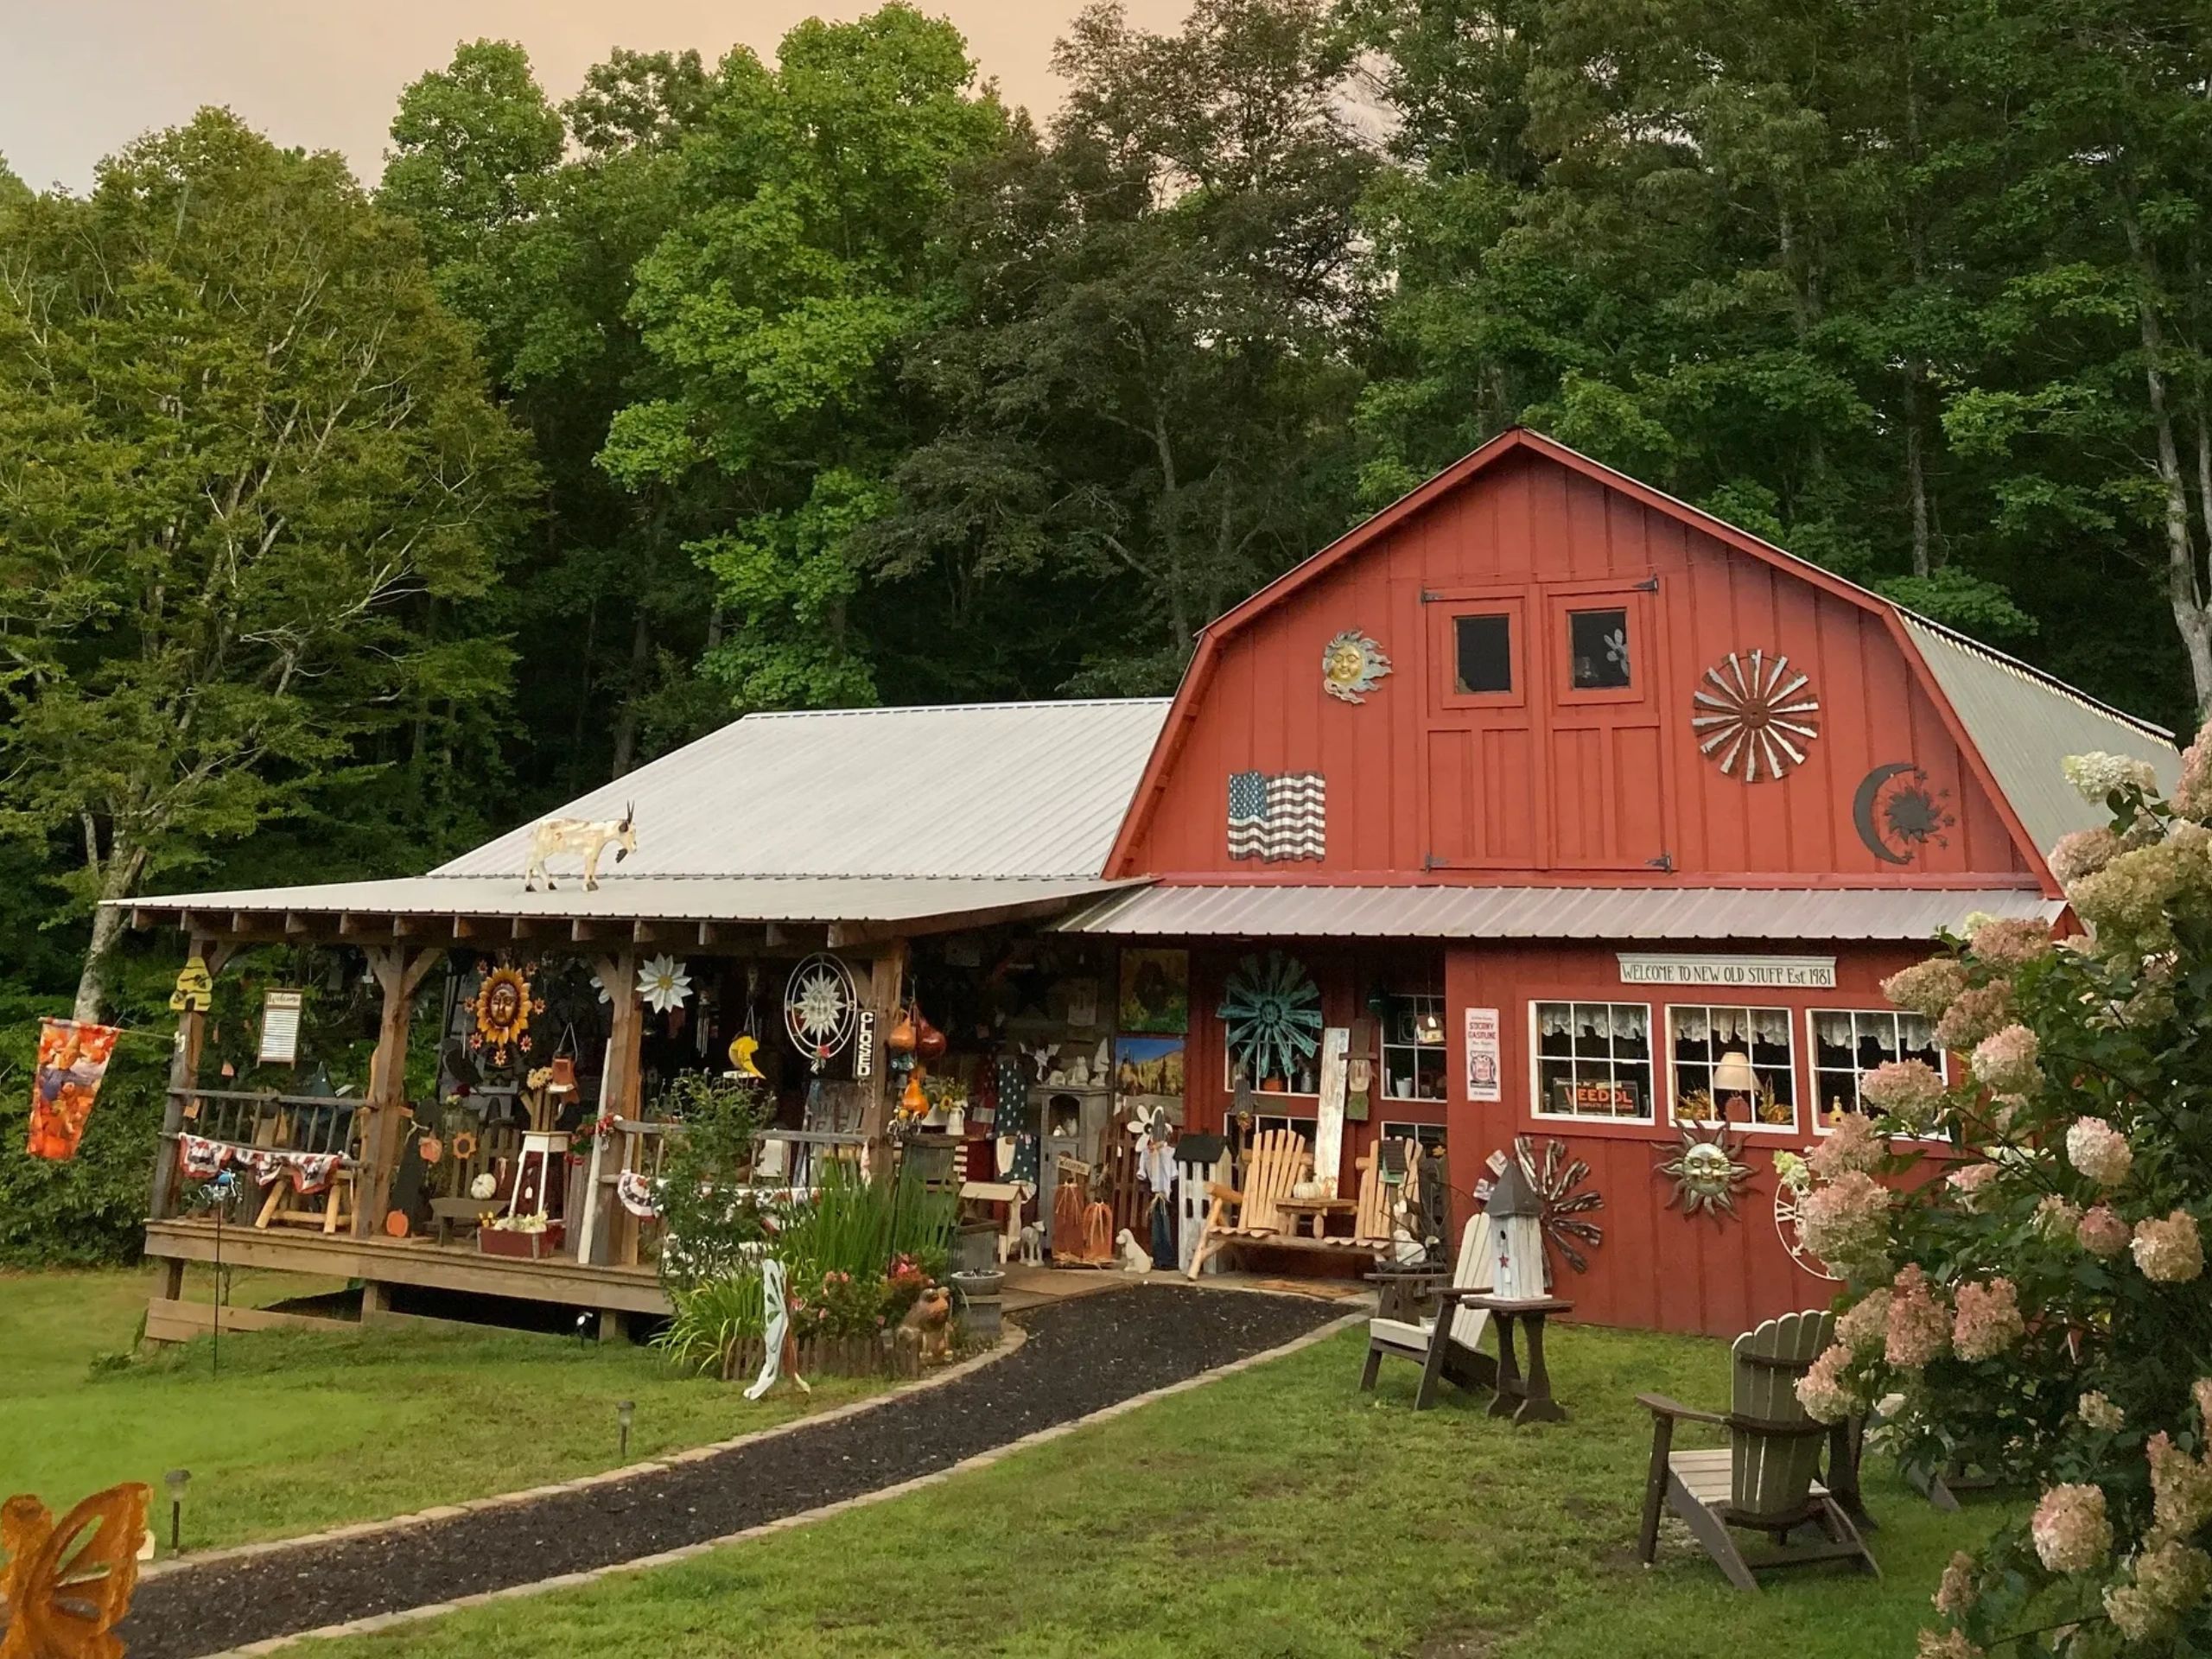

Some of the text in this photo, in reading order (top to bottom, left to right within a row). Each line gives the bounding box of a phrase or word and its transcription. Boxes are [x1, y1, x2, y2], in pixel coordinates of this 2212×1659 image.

[1622, 964, 1831, 985] WELCOME TO NEW OLD STUFF Est 1981
[856, 1011, 874, 1077] CLOSED
